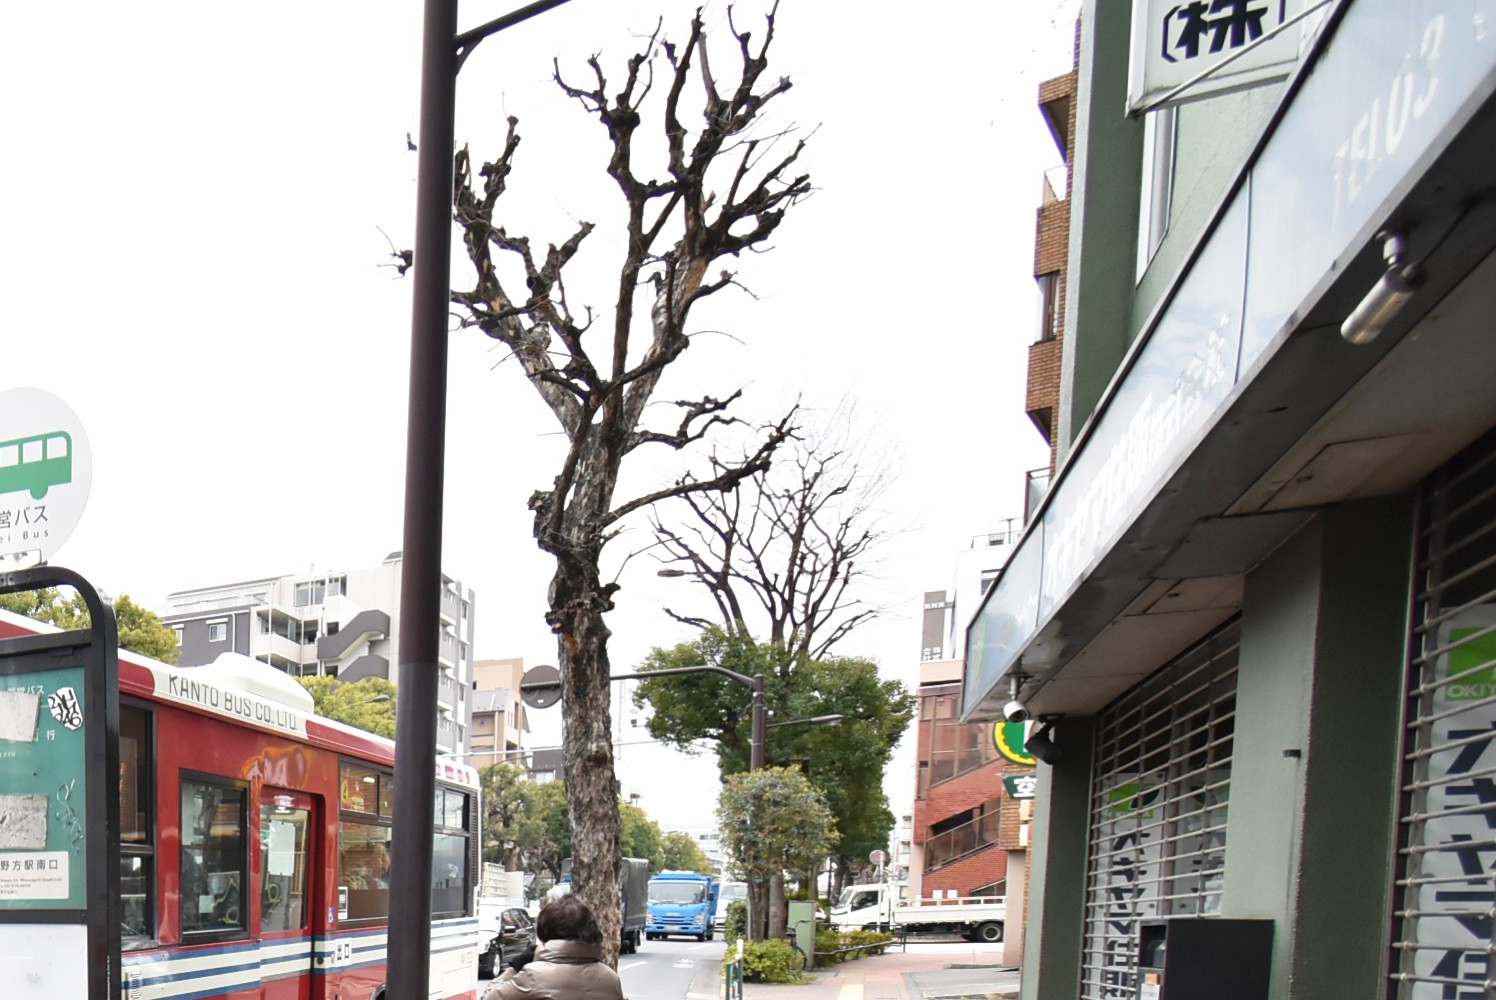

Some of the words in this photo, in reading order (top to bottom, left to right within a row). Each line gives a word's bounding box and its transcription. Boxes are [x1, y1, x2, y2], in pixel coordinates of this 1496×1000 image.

[23, 529, 49, 540] Bus
[169, 674, 219, 708] KANTO
[224, 692, 252, 717] BUS
[0, 859, 58, 871] 野方駅南口
